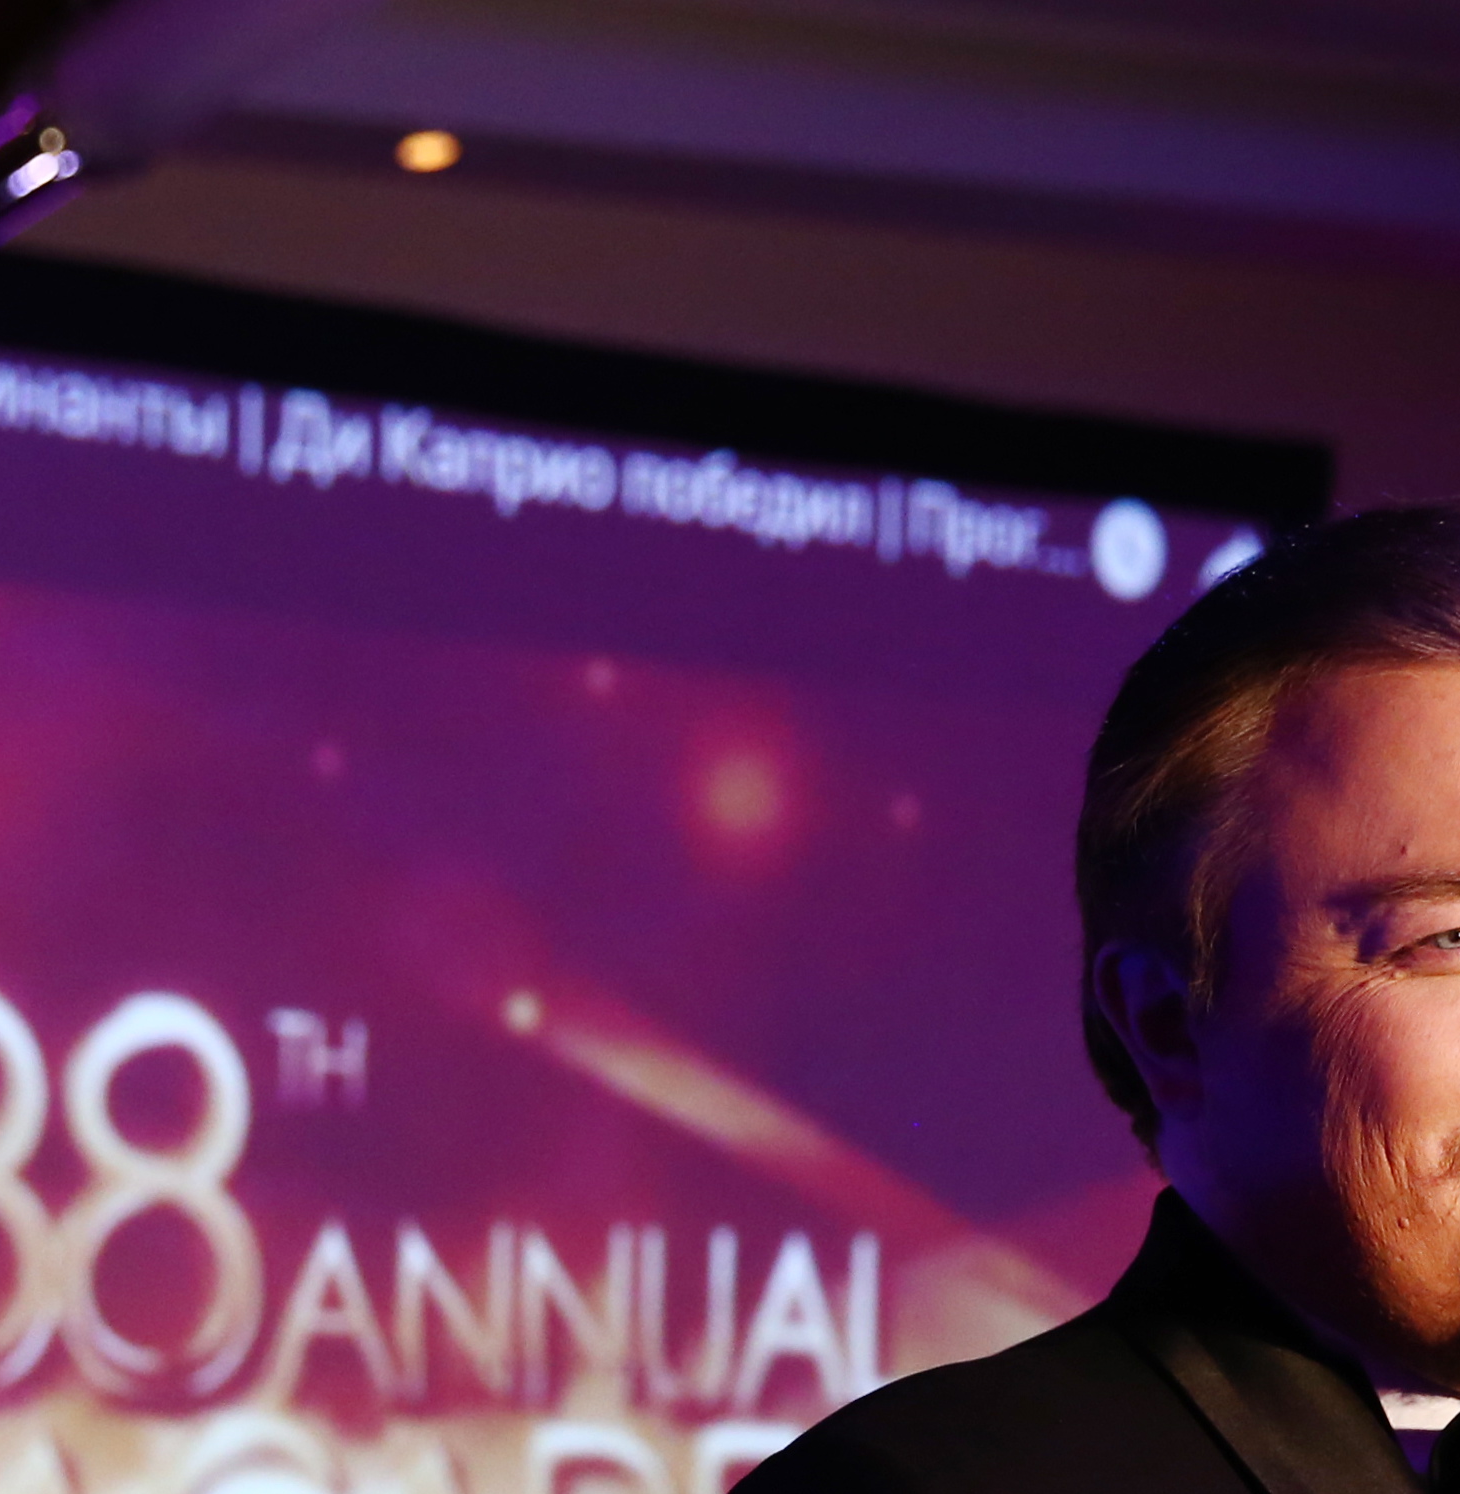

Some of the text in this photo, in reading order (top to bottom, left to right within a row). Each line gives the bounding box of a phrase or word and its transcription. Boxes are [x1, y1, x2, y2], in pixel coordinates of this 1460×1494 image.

[268, 388, 373, 490] Ди
[267, 1008, 369, 1106] TH
[271, 1218, 884, 1408] ANNUAL
